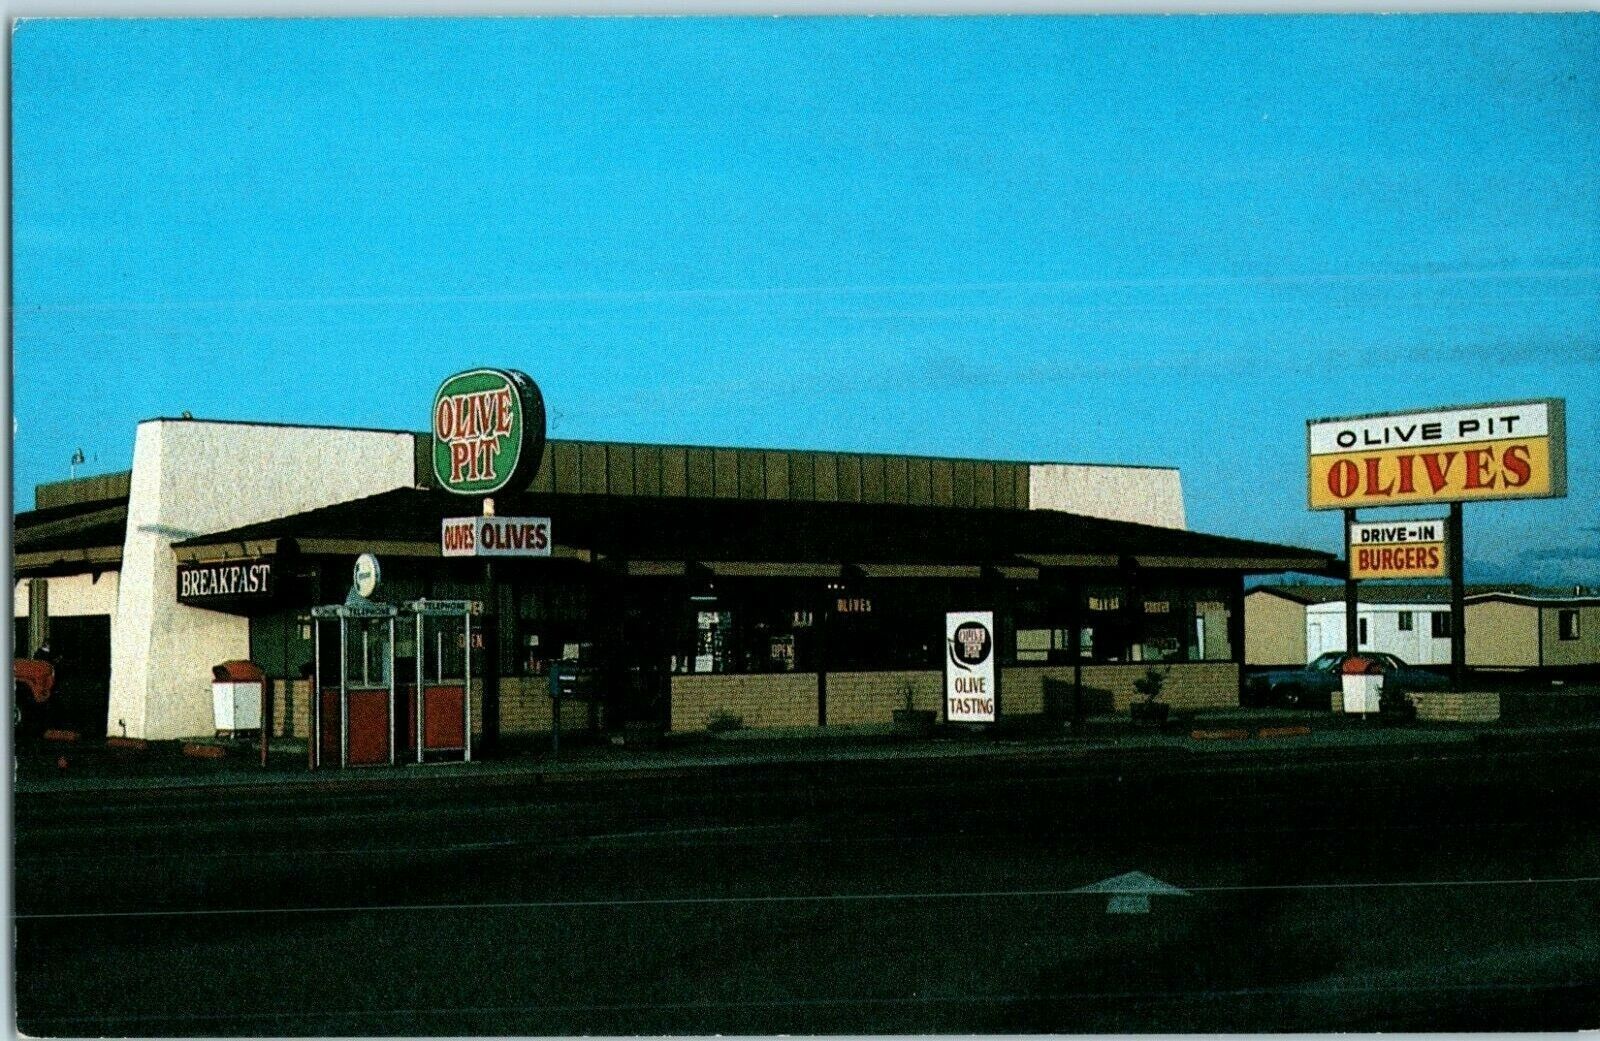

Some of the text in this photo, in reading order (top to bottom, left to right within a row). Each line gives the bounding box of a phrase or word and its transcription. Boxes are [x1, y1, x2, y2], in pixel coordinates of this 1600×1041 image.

[437, 386, 512, 441] OLIVE
[1336, 415, 1520, 448] OLIVE PIT
[450, 437, 500, 482] PIT
[1327, 444, 1532, 499] OLIVES
[444, 524, 475, 551] OLIVES
[480, 523, 548, 550] OLIVES
[1361, 526, 1435, 543] DRIVE-IN
[1358, 546, 1440, 572] BURGERS
[181, 564, 271, 597] BREAKFAST
[955, 677, 986, 693] OLIVE
[949, 698, 994, 714] TASTING
